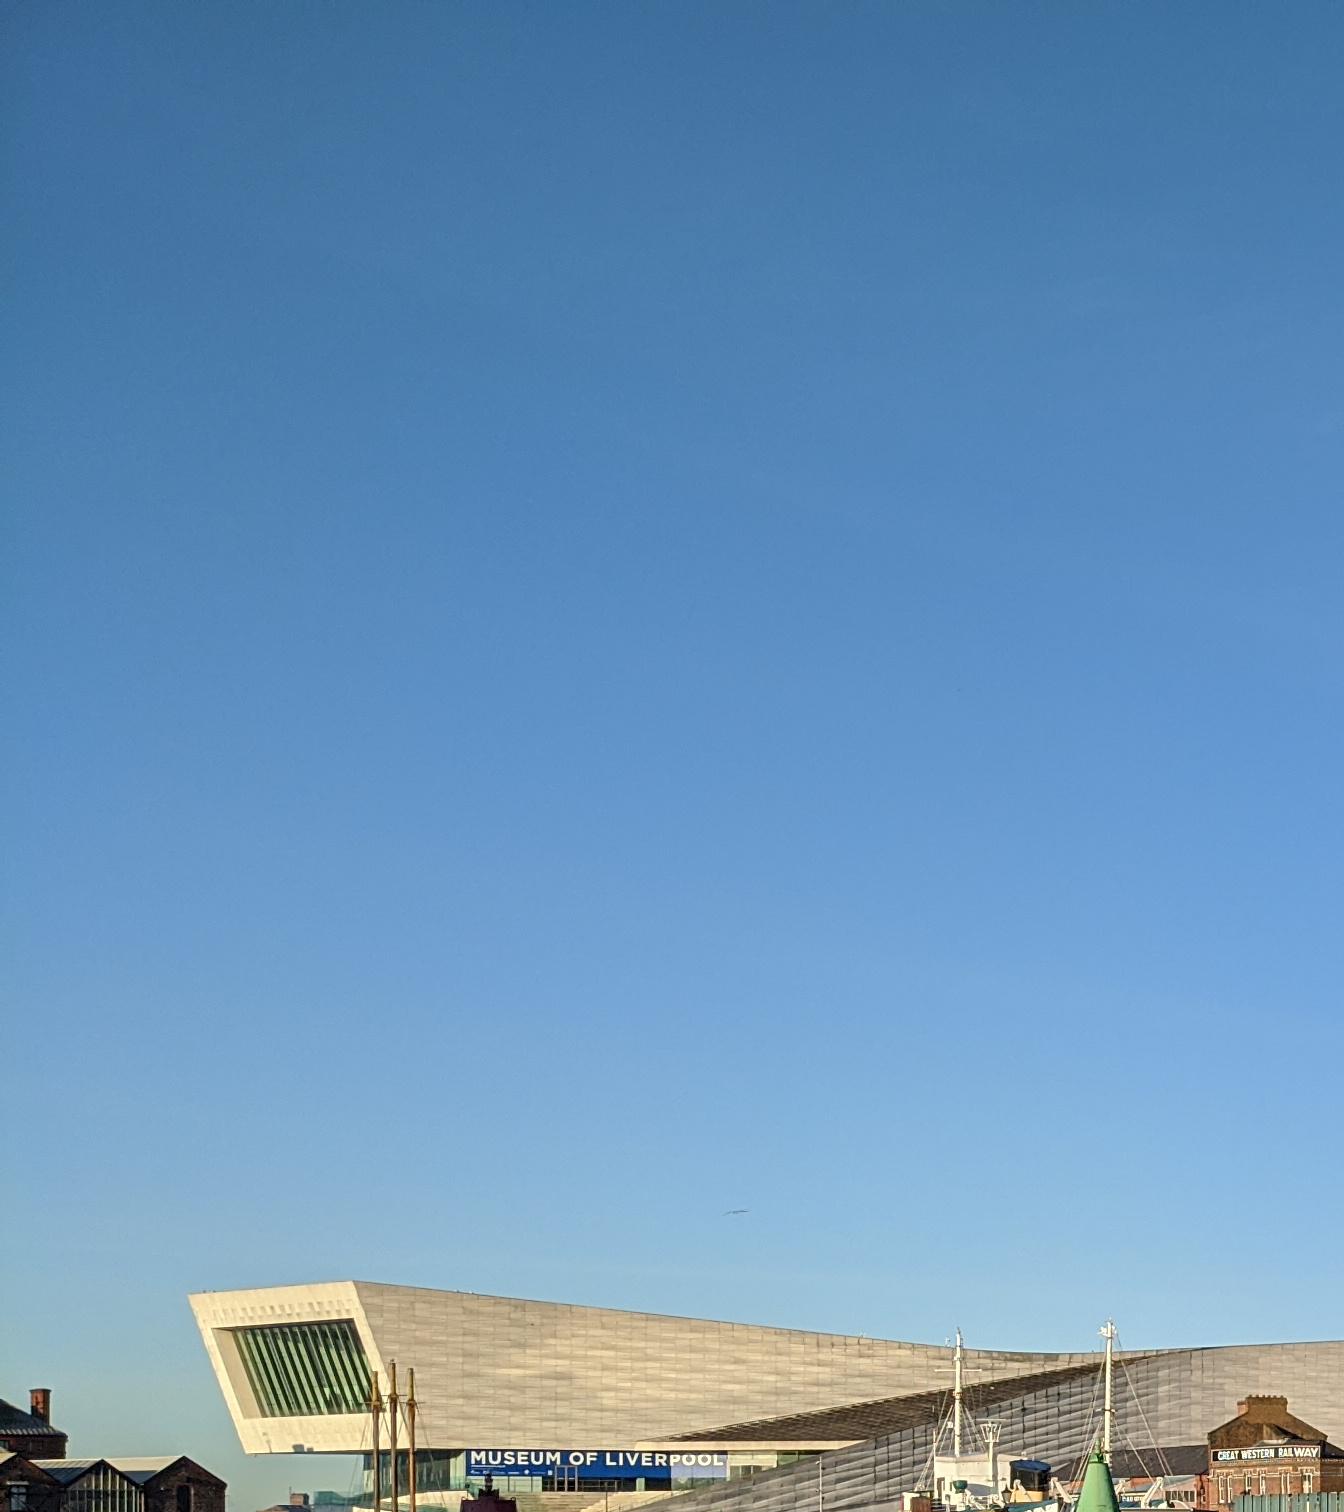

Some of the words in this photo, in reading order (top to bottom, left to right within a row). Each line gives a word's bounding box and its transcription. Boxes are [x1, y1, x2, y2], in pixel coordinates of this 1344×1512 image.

[470, 1451, 561, 1465] MUSEUM
[568, 1452, 598, 1465] OF
[605, 1452, 724, 1466] LIVERPOOL
[1218, 1451, 1239, 1460] GREAT
[1241, 1449, 1275, 1459] WESTERN
[1279, 1447, 1318, 1458] RAILWAY
